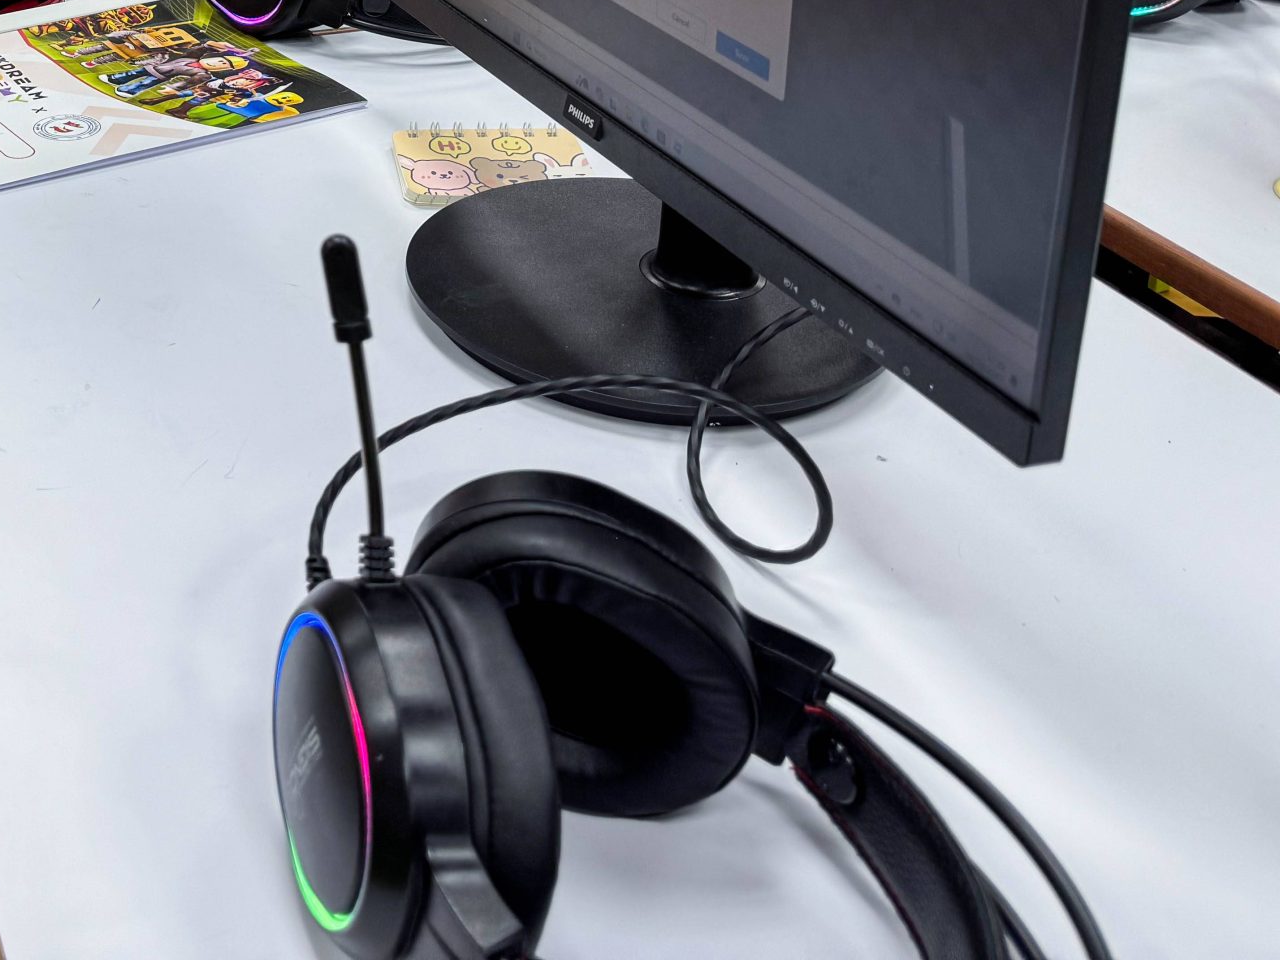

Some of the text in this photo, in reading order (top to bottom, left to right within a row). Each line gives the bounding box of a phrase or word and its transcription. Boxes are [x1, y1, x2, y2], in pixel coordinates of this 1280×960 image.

[672, 12, 690, 28] Cancel
[568, 104, 594, 129] PHILIPS
[438, 141, 462, 151] Hi
